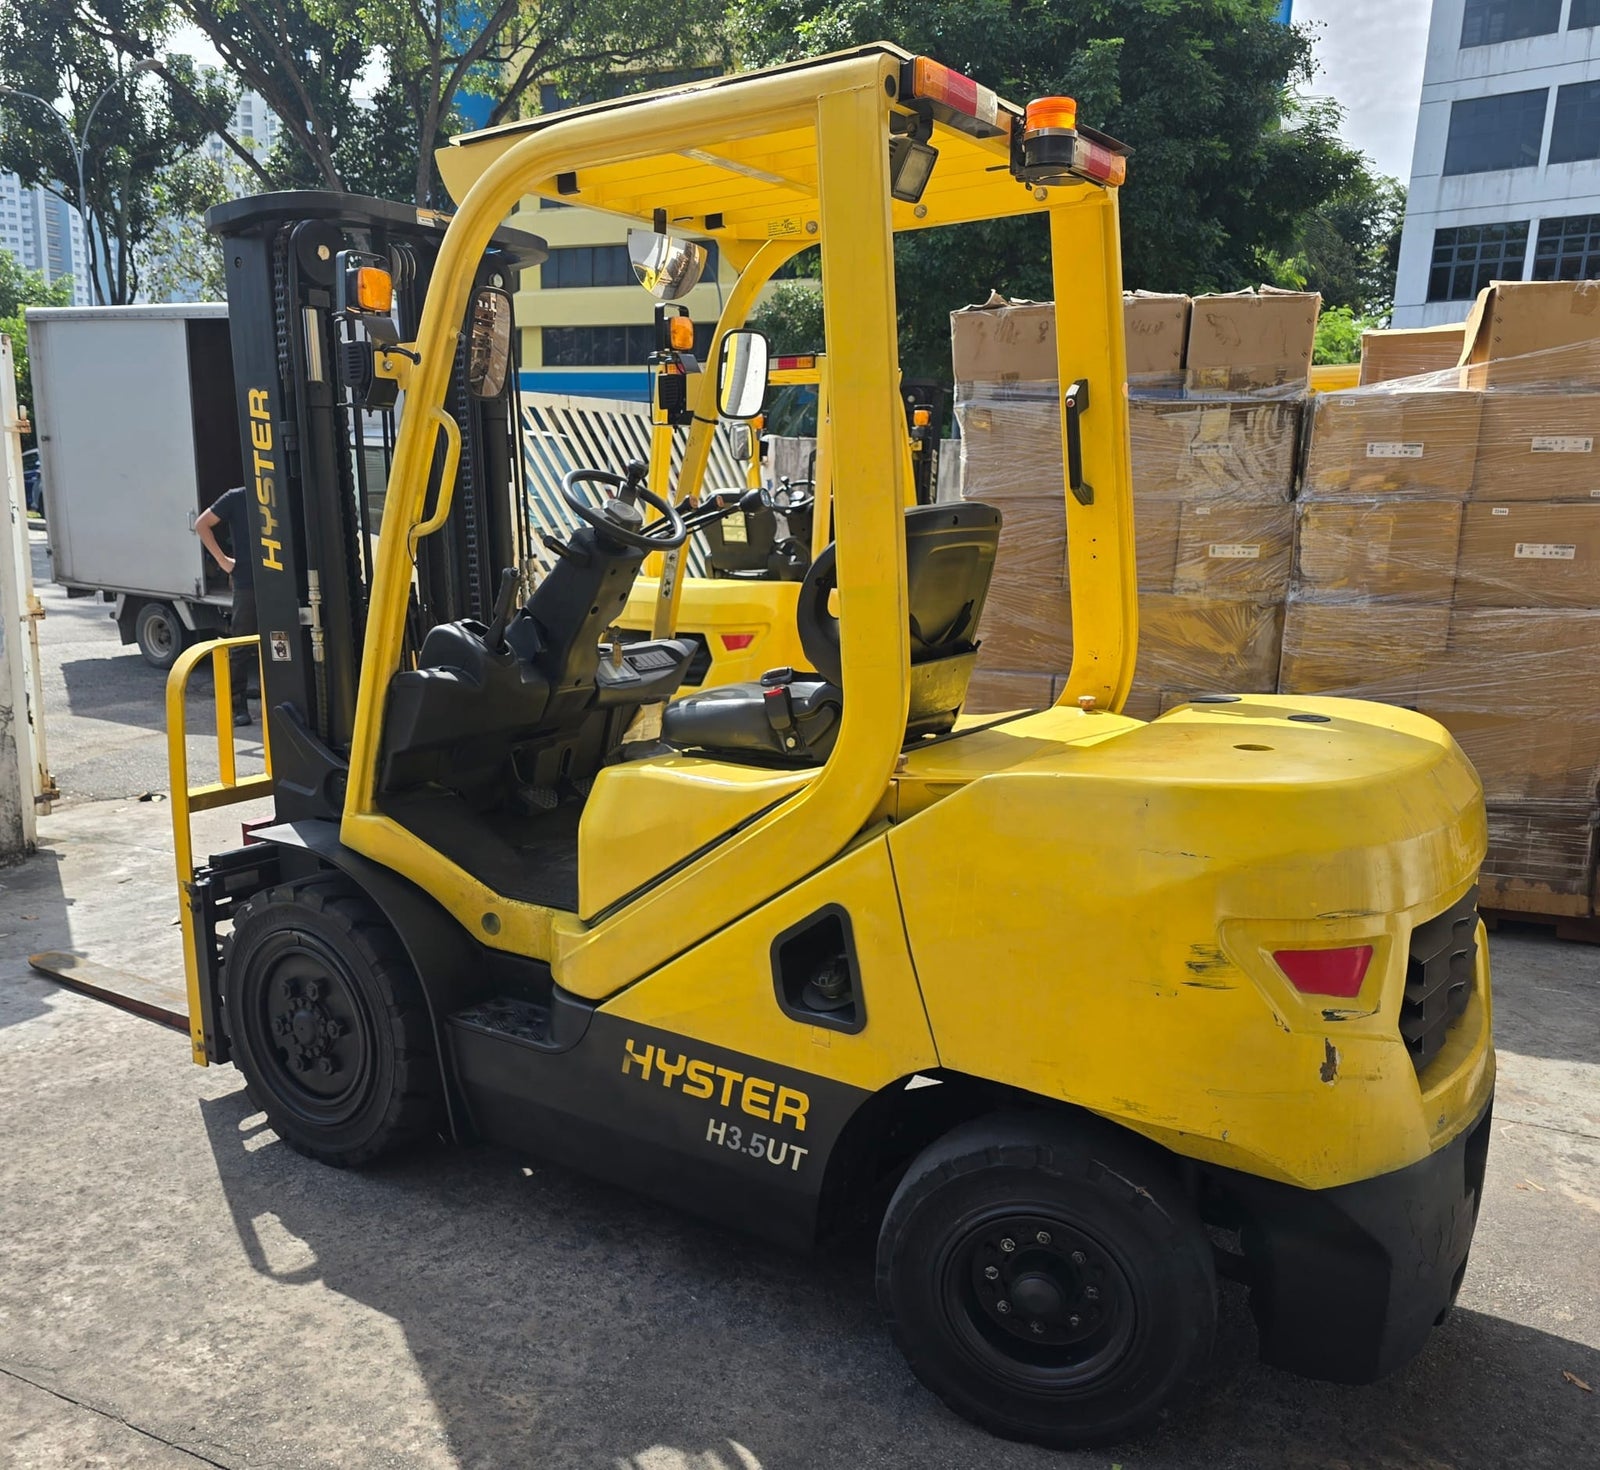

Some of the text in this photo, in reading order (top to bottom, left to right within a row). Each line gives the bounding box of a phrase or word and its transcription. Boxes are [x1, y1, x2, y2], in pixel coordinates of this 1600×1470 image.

[248, 388, 284, 571] HYSTER
[621, 1038, 810, 1131] HYSTER
[706, 1118, 808, 1171] H3.5UT
